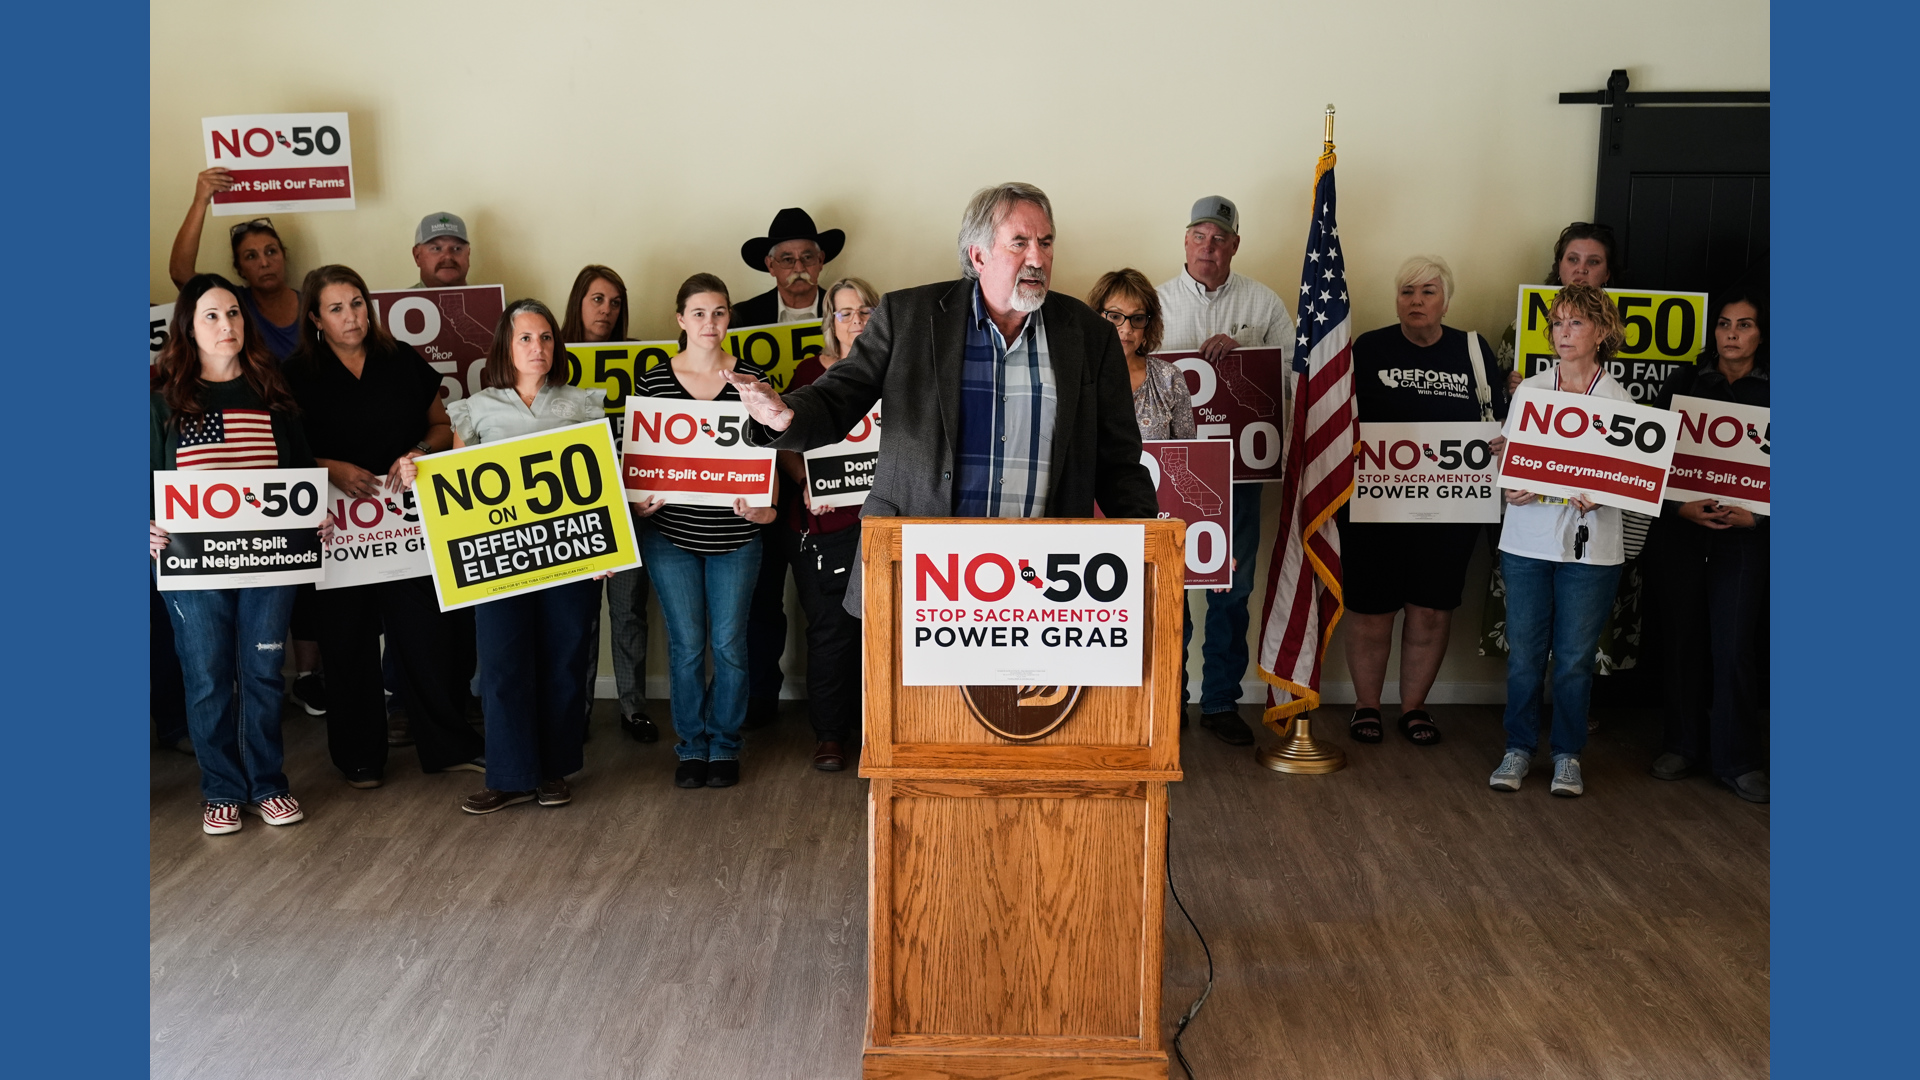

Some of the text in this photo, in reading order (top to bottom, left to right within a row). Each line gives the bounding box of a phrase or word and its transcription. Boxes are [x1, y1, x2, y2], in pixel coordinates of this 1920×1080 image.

[212, 128, 274, 159] NO
[292, 126, 341, 156] 50
[218, 178, 345, 192] on't Split Our Farms
[150, 319, 170, 351] 5
[1172, 358, 1217, 408] O
[1390, 368, 1468, 386] REFORM
[1401, 380, 1468, 393] CALIFORNIA
[632, 411, 697, 445] NO
[1519, 401, 1589, 438] NO
[1605, 414, 1666, 453] 50
[1677, 410, 1743, 448] NO
[1358, 440, 1420, 470] NO
[1438, 439, 1492, 470] 50
[432, 444, 602, 516] NO 50
[629, 466, 765, 482] Don't Split Our Farms
[1359, 474, 1492, 483] STOP SACRAMENTO'S
[1511, 455, 1656, 491] Stop Gerrymandering
[1706, 471, 1737, 484] Split
[1741, 476, 1766, 489] Our
[816, 479, 841, 490] Our
[1358, 486, 1492, 498] POWER GRAB
[165, 483, 240, 519] NO
[261, 481, 318, 517] 50
[489, 506, 518, 525] ON
[204, 537, 287, 552] Don't Split
[458, 512, 602, 560] DEFEND FAIR
[167, 551, 318, 569] Our Neighborhoods
[463, 533, 607, 582] ELECTIONS
[554, 569, 576, 577] REPUBLICAN
[916, 553, 1015, 602] NO
[1043, 553, 1128, 602] 50
[916, 609, 1128, 622] STOP SACRAMENTO'S
[916, 626, 1128, 647] POWER GRAB
